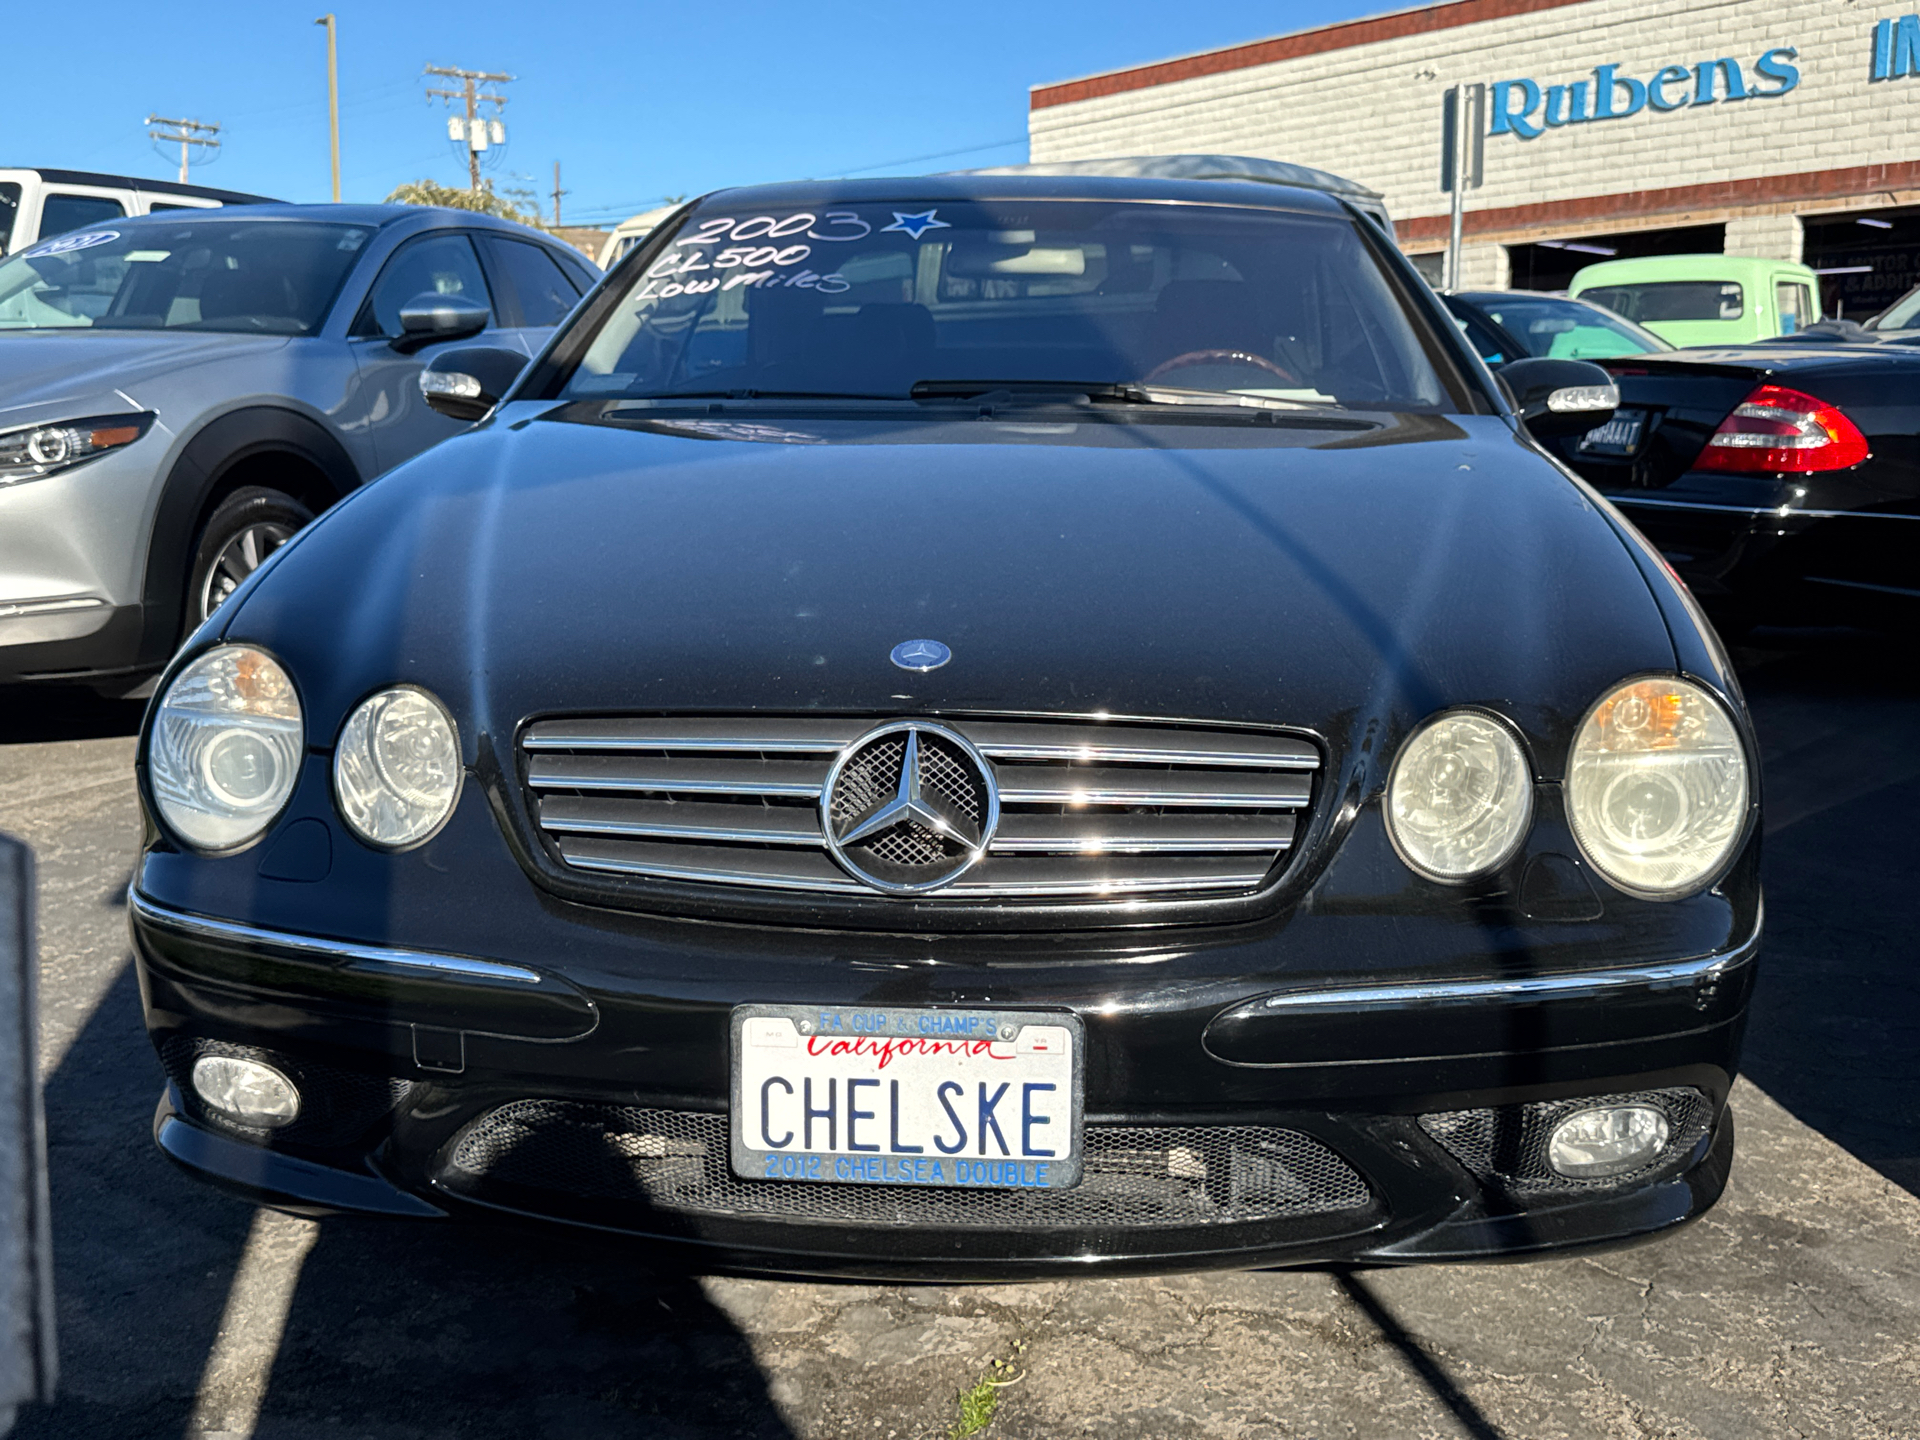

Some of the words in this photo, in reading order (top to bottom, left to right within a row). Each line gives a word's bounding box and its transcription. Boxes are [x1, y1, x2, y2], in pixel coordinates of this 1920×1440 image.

[1487, 46, 1800, 140] Rubens
[676, 212, 871, 247] 2003
[819, 1012, 843, 1032] FA
[852, 1013, 887, 1033] CUP
[898, 1016, 909, 1033] &
[918, 1014, 997, 1036] CHAMP'S
[807, 1035, 1016, 1070] California
[760, 1075, 1056, 1157] CHELSKE
[765, 1154, 822, 1180] 2012
[835, 1157, 945, 1186] CHELSEA
[955, 1160, 1051, 1188] DOUBLE
